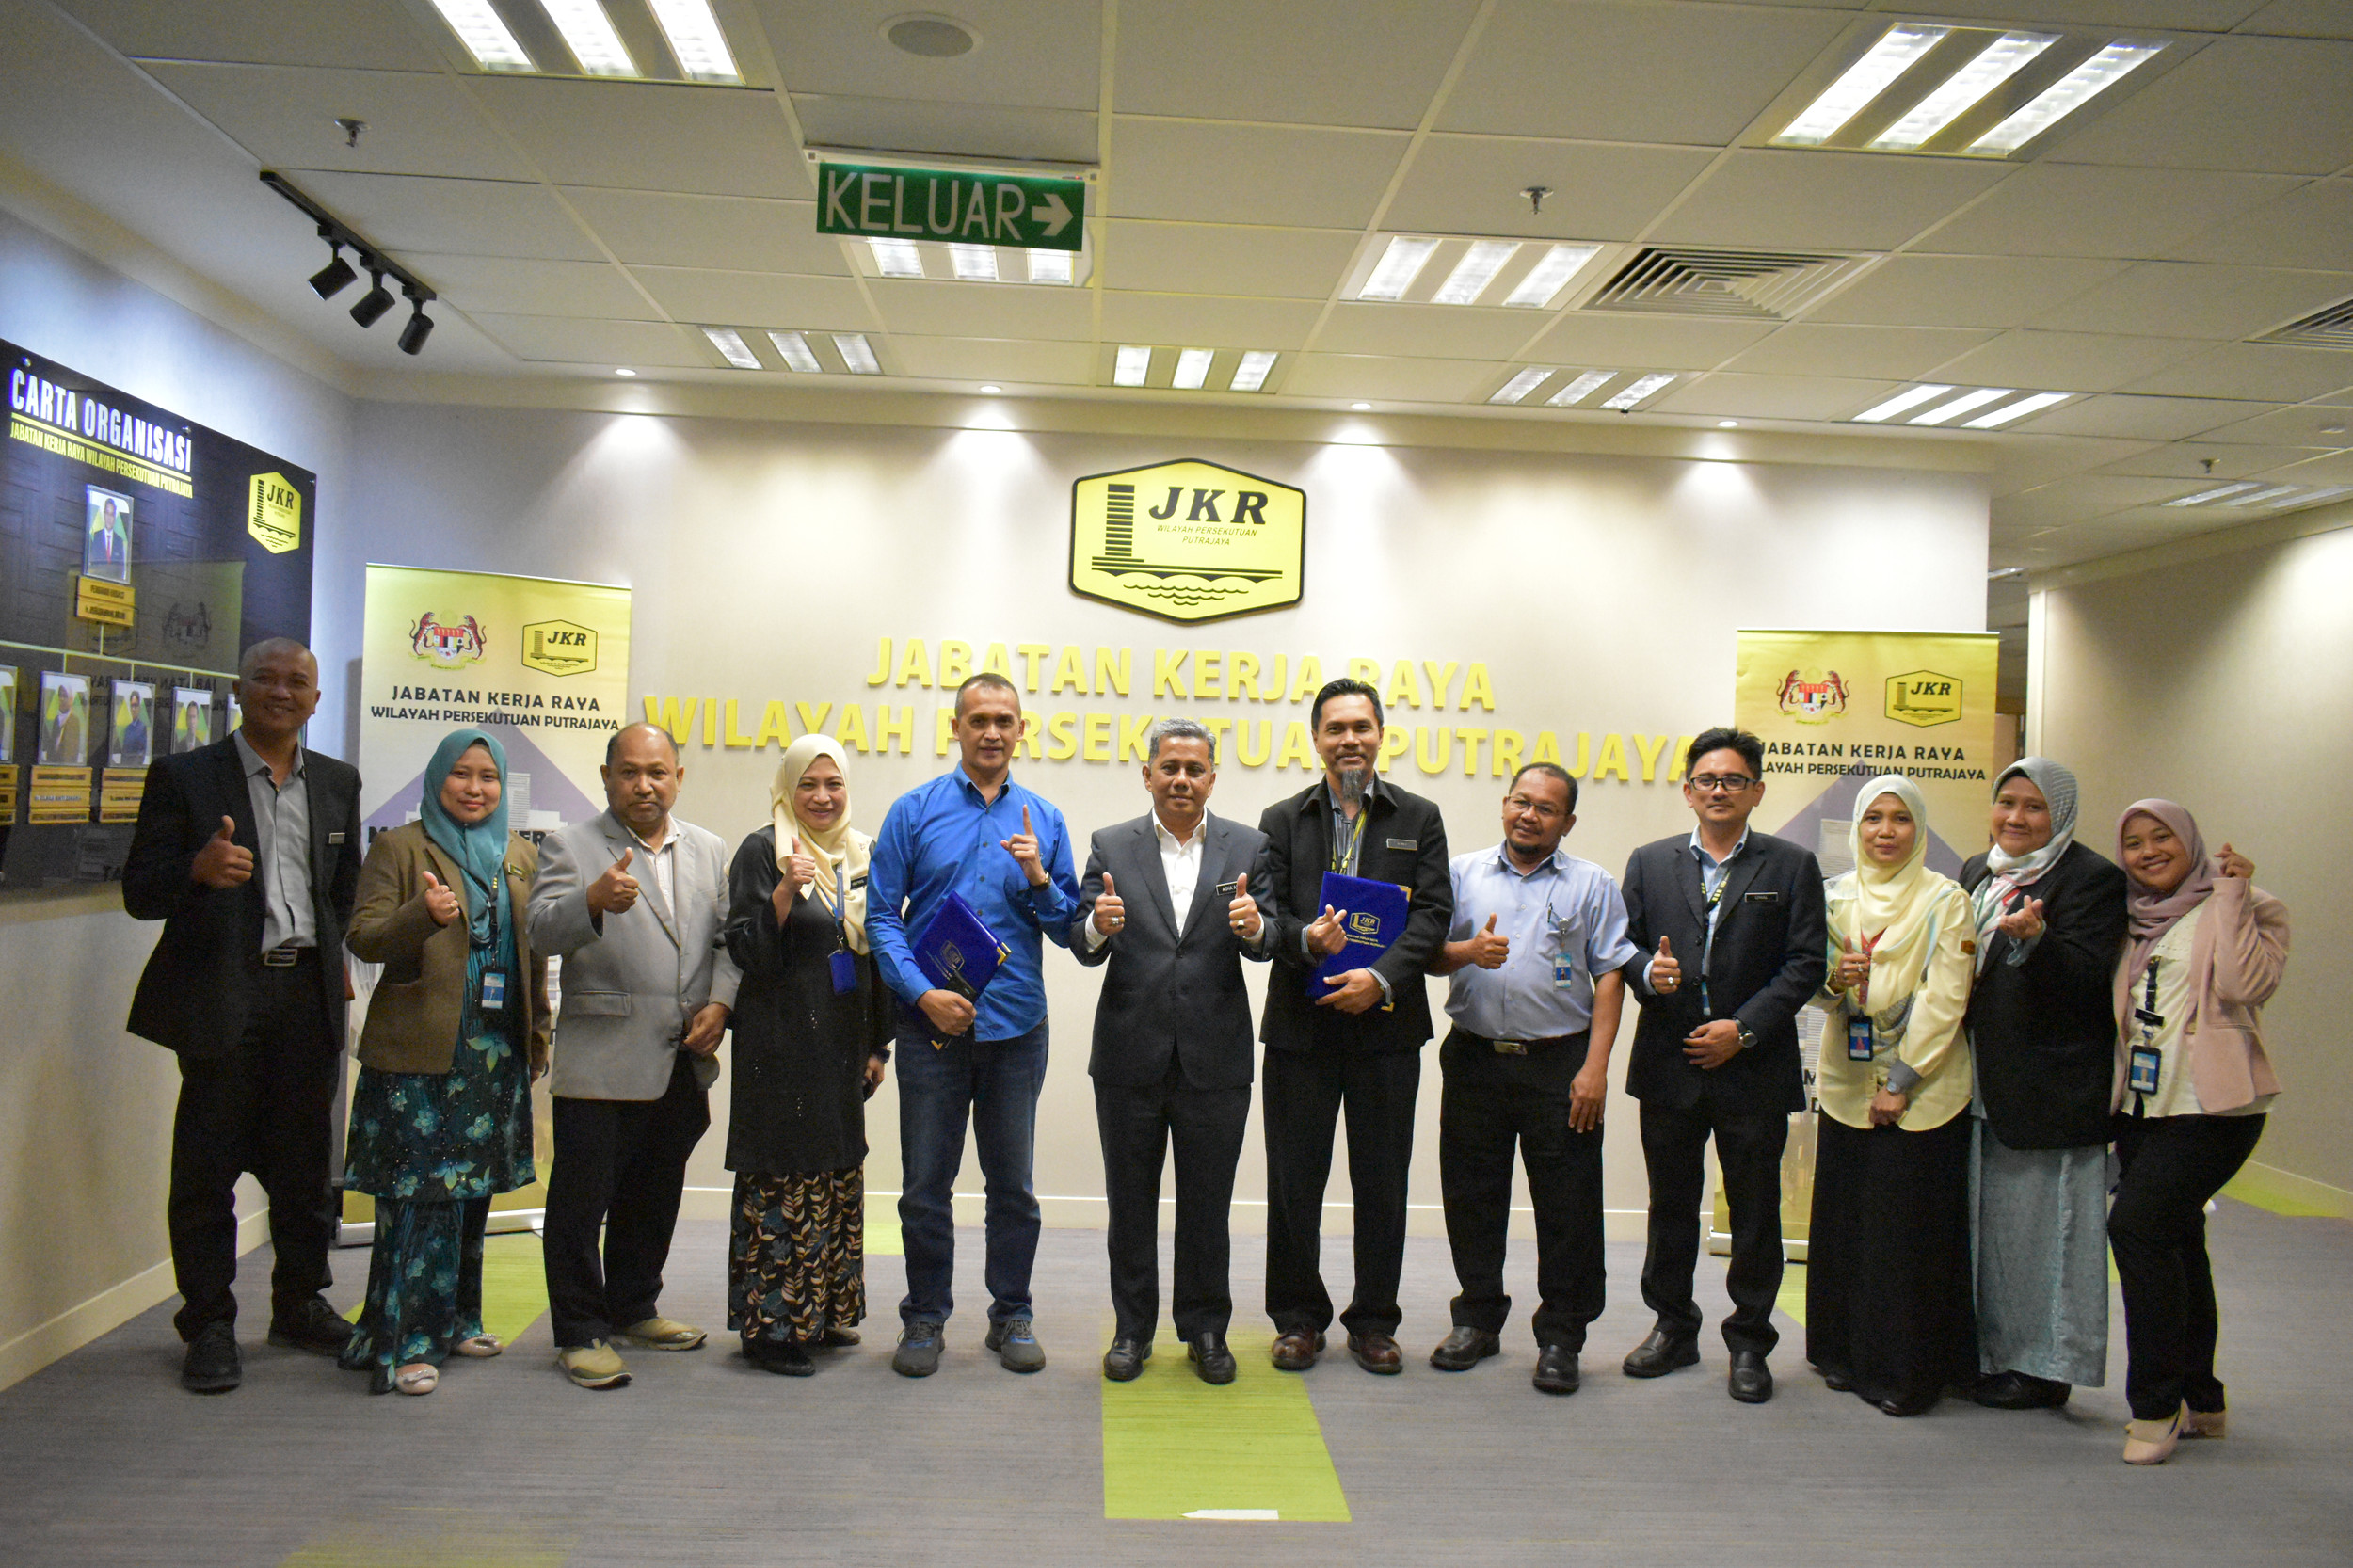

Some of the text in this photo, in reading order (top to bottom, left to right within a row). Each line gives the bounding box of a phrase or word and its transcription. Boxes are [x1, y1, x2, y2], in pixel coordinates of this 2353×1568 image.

[825, 170, 1026, 241] KELUAR
[10, 367, 192, 473] CARTA ORGANISASI
[10, 421, 44, 448] JABATAN
[44, 433, 67, 456] KERJA
[67, 441, 86, 462] RAYA
[86, 447, 115, 472] WILAYAH
[267, 484, 295, 510] JKR
[1148, 486, 1269, 525] JKR
[1157, 524, 1257, 536] WILAYAH PERSEKUTUAN
[1182, 536, 1230, 546] PUTRAJAYA
[547, 631, 587, 647] JKR
[867, 637, 1132, 696] JABATAN
[1154, 648, 1325, 702] KERJA
[392, 685, 600, 712] JABATAN KERJA RAYA
[1910, 681, 1952, 696] JKR
[371, 706, 619, 731] WILAYAH PERSEKUTUAN PUTRAJAYA
[643, 696, 914, 754] WILAYAH
[1850, 744, 1907, 760] KERJA
[1914, 746, 1965, 761] RAYA
[1807, 763, 1903, 777] PERSEKUTUAN
[1907, 766, 1986, 781] PUTRAJAYA
